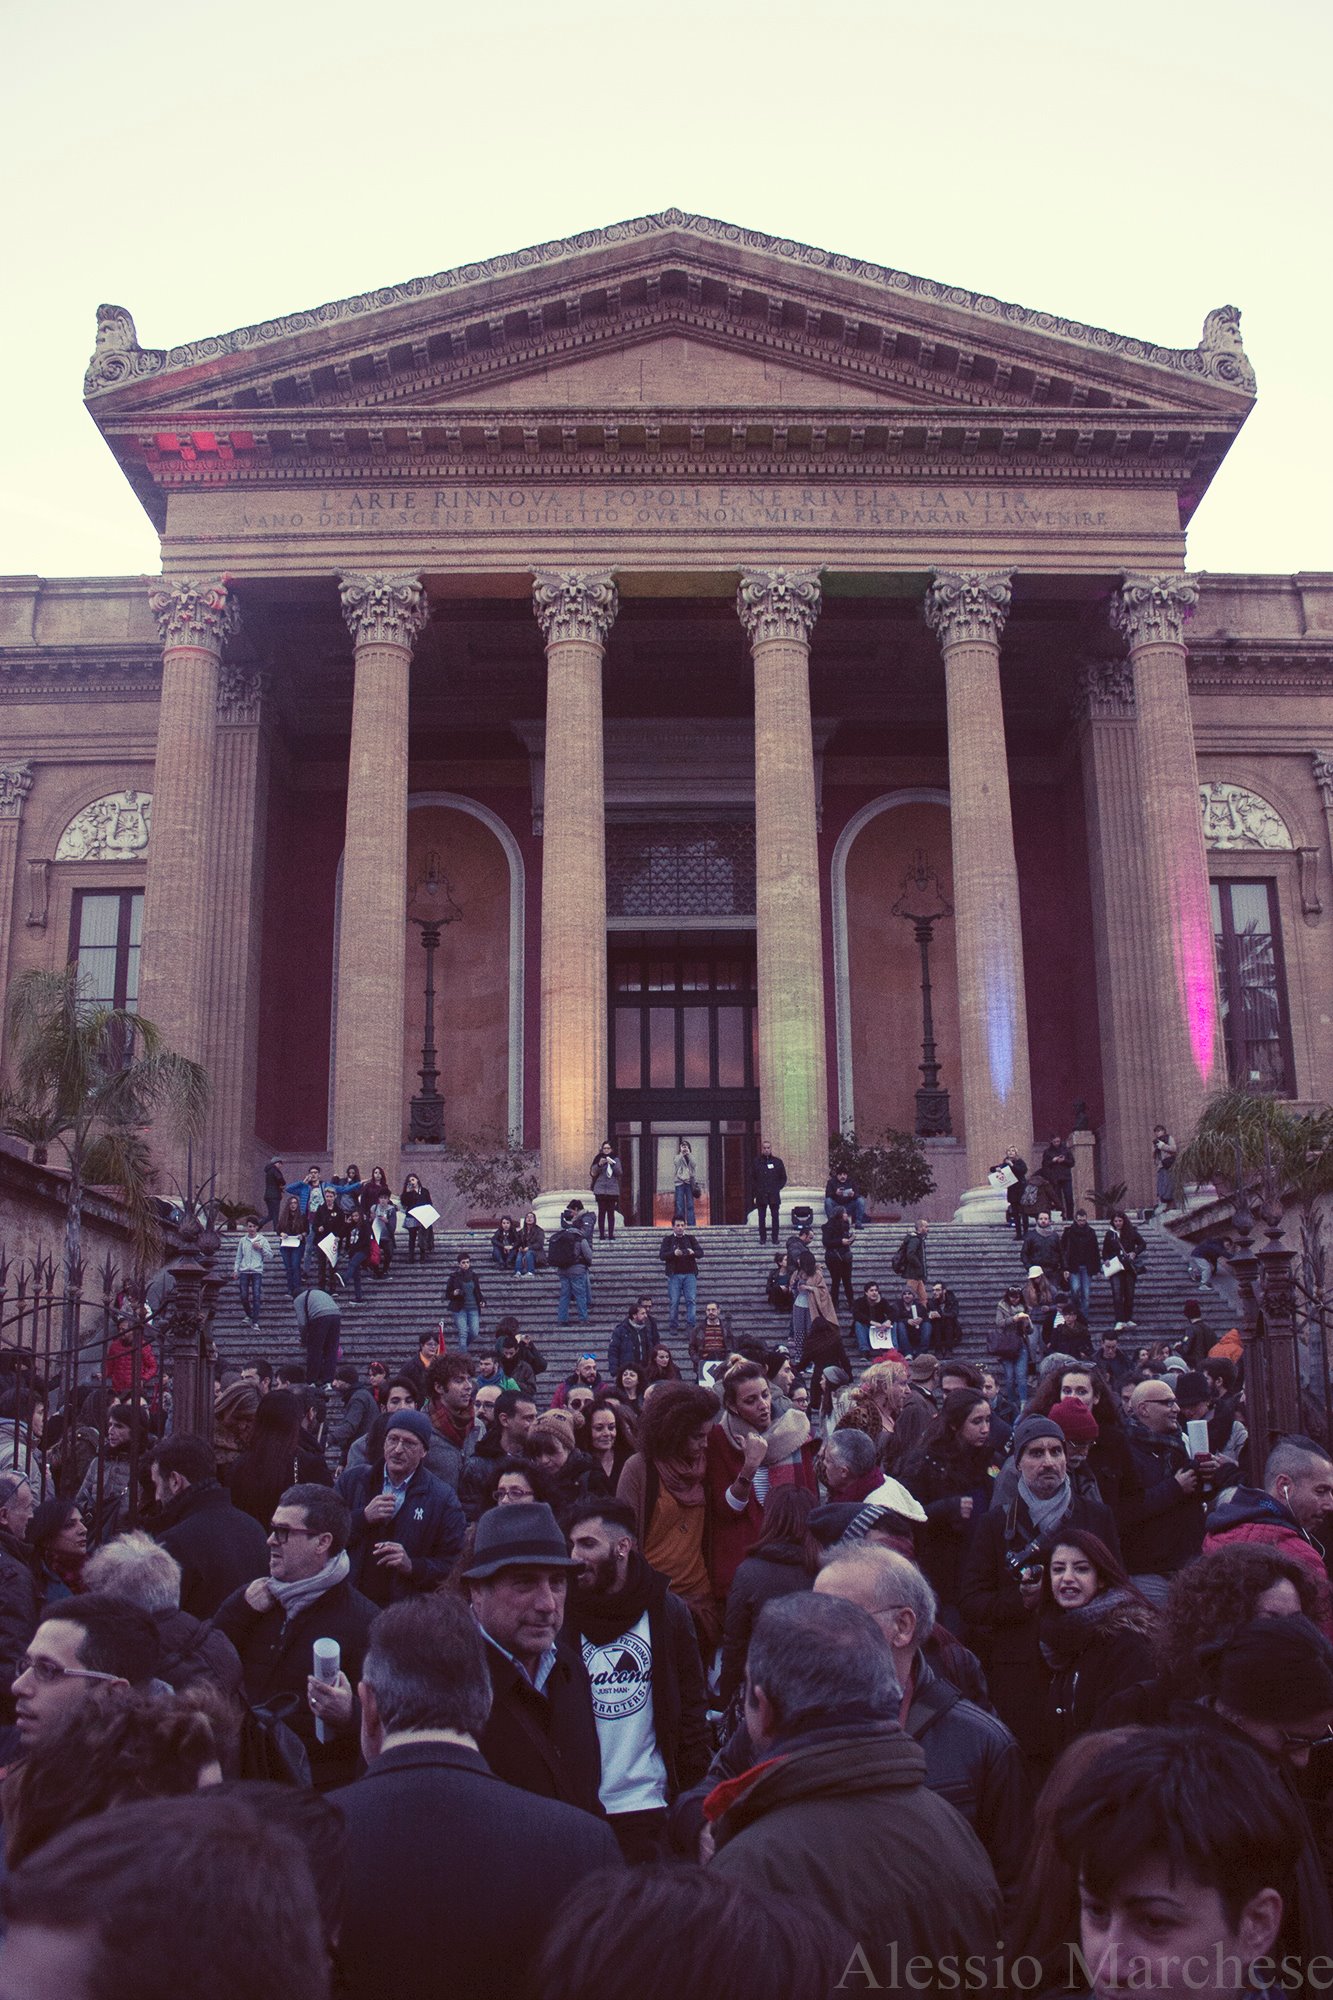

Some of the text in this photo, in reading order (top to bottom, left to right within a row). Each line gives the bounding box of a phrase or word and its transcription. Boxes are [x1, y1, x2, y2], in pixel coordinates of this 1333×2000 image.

[434, 490, 563, 508] RINNOVA
[578, 490, 585, 507] I
[604, 489, 700, 507] POPOLI
[720, 489, 731, 506] E
[748, 489, 783, 507] NE
[801, 489, 904, 507] RIVELA
[920, 490, 950, 508] LA
[963, 490, 1029, 509] VITA
[399, 510, 474, 525] SCENE
[490, 510, 511, 523] IL
[527, 509, 619, 523] DILETTO
[637, 508, 679, 522] OVE
[697, 508, 744, 522] NON
[765, 508, 815, 522] MIRI
[831, 509, 841, 522] A
[854, 509, 969, 524] PREPARAR
[620, 1636, 650, 1668] FICTIONAL
[592, 1689, 645, 1713] ARACTERS
[597, 1687, 613, 1695] JUST
